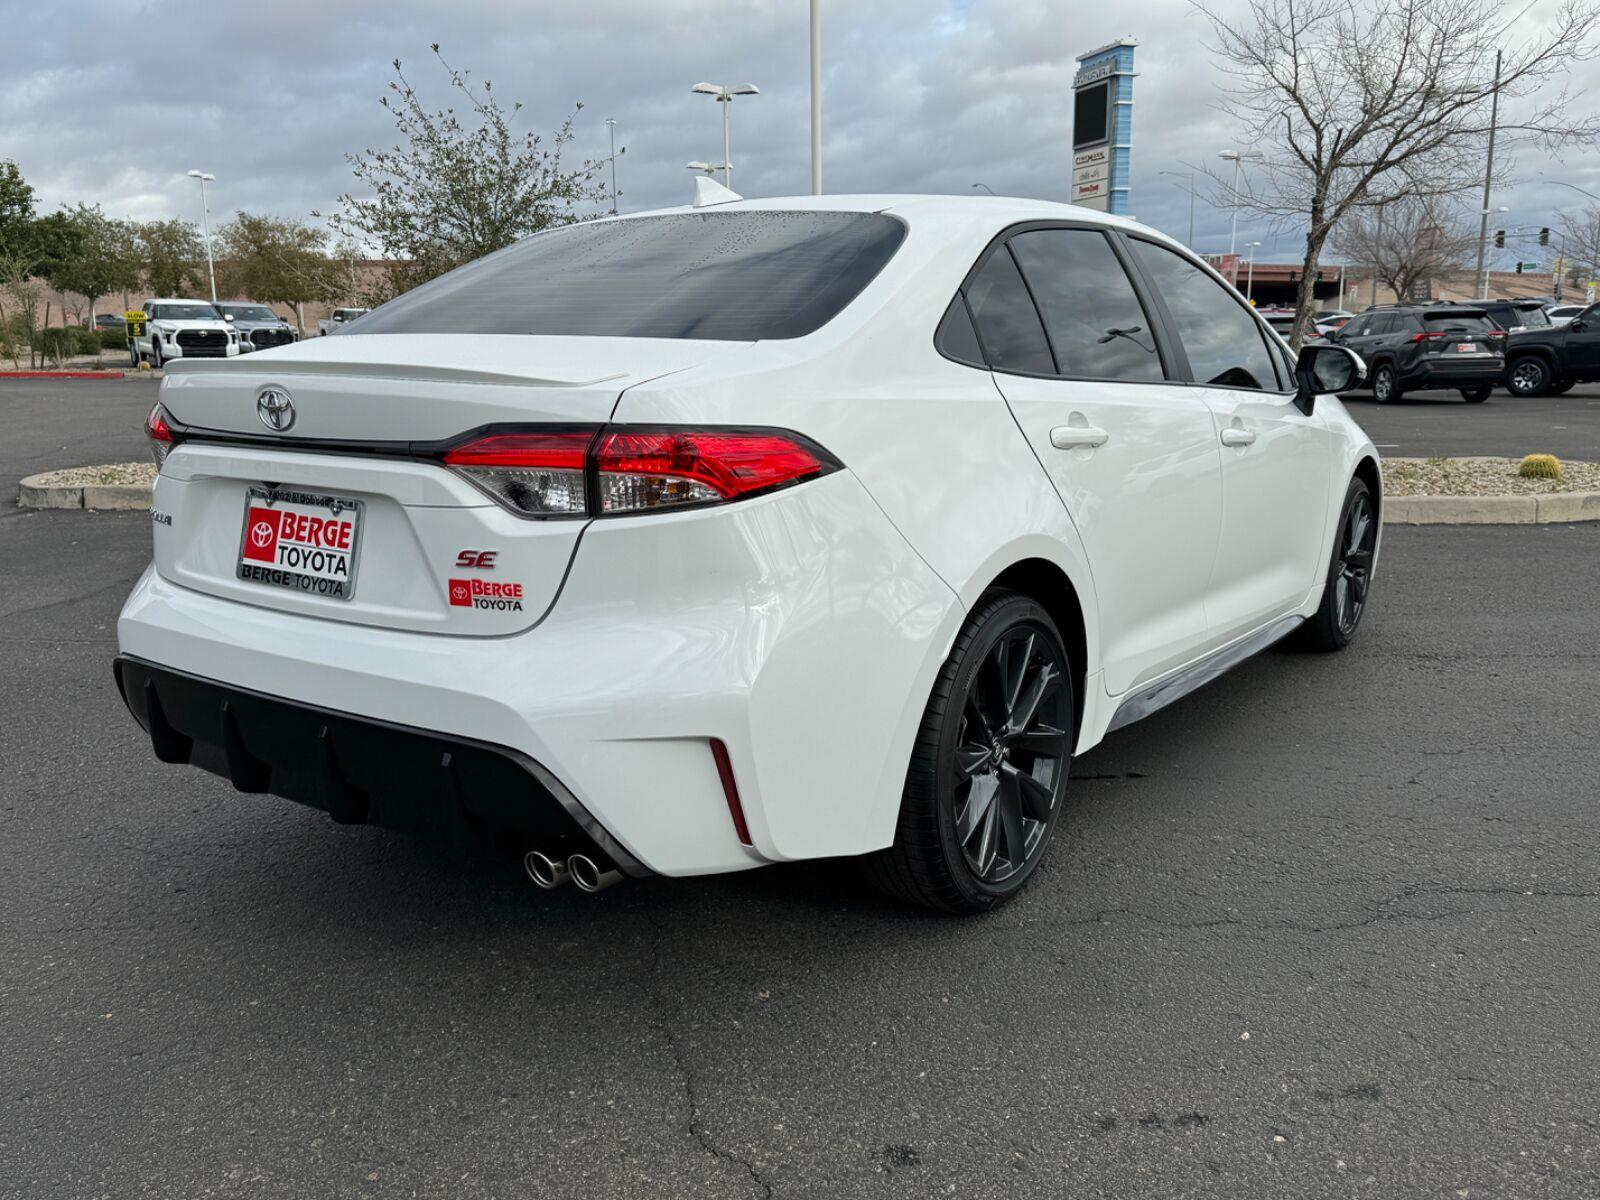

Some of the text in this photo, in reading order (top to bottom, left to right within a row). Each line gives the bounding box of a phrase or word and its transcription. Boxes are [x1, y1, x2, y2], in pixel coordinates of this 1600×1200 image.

[281, 511, 352, 549] BERGE
[278, 545, 347, 576] TOYOTA
[455, 550, 498, 569] SE
[241, 564, 344, 596] BERGE TOYOTA
[471, 578, 523, 598] BERGE
[472, 598, 523, 612] TOYOTA
